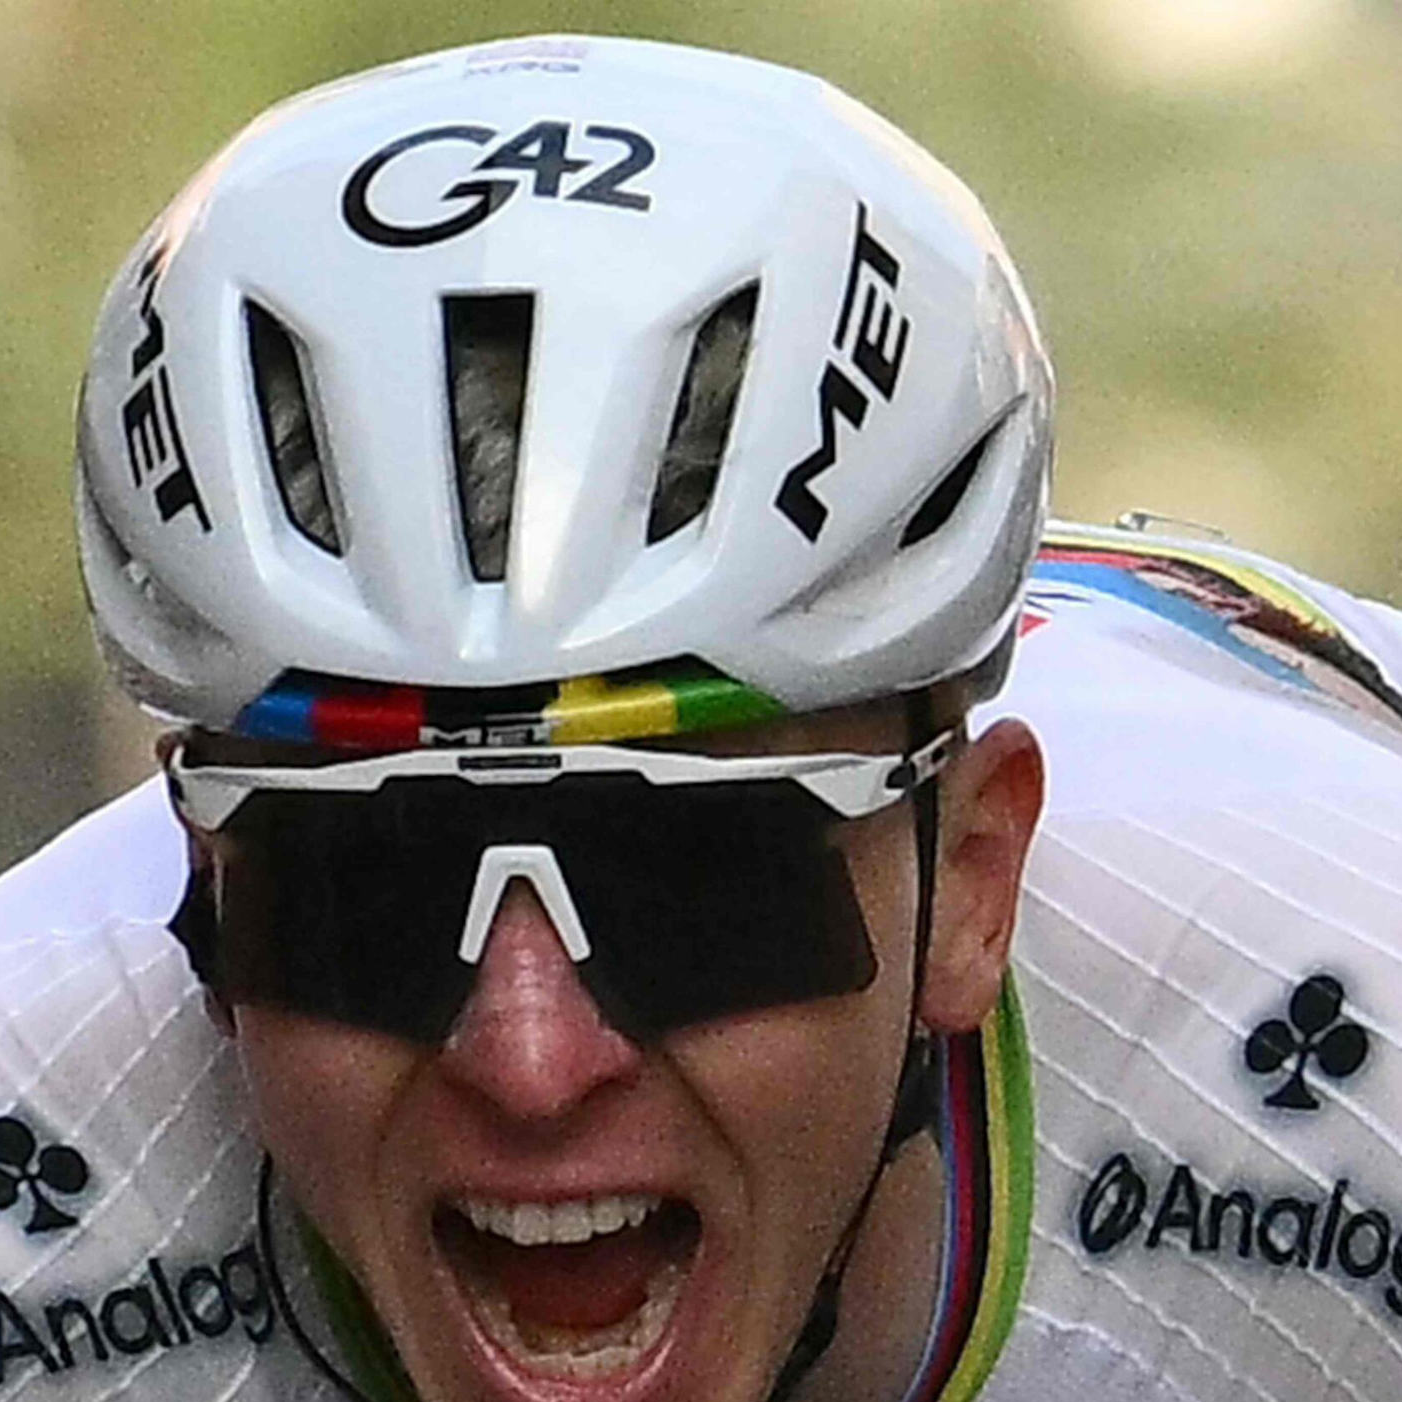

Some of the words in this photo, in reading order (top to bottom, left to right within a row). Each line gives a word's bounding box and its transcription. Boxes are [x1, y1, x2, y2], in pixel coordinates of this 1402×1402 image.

[342, 121, 655, 248] G42
[123, 244, 212, 533] MET
[774, 199, 911, 544] MET
